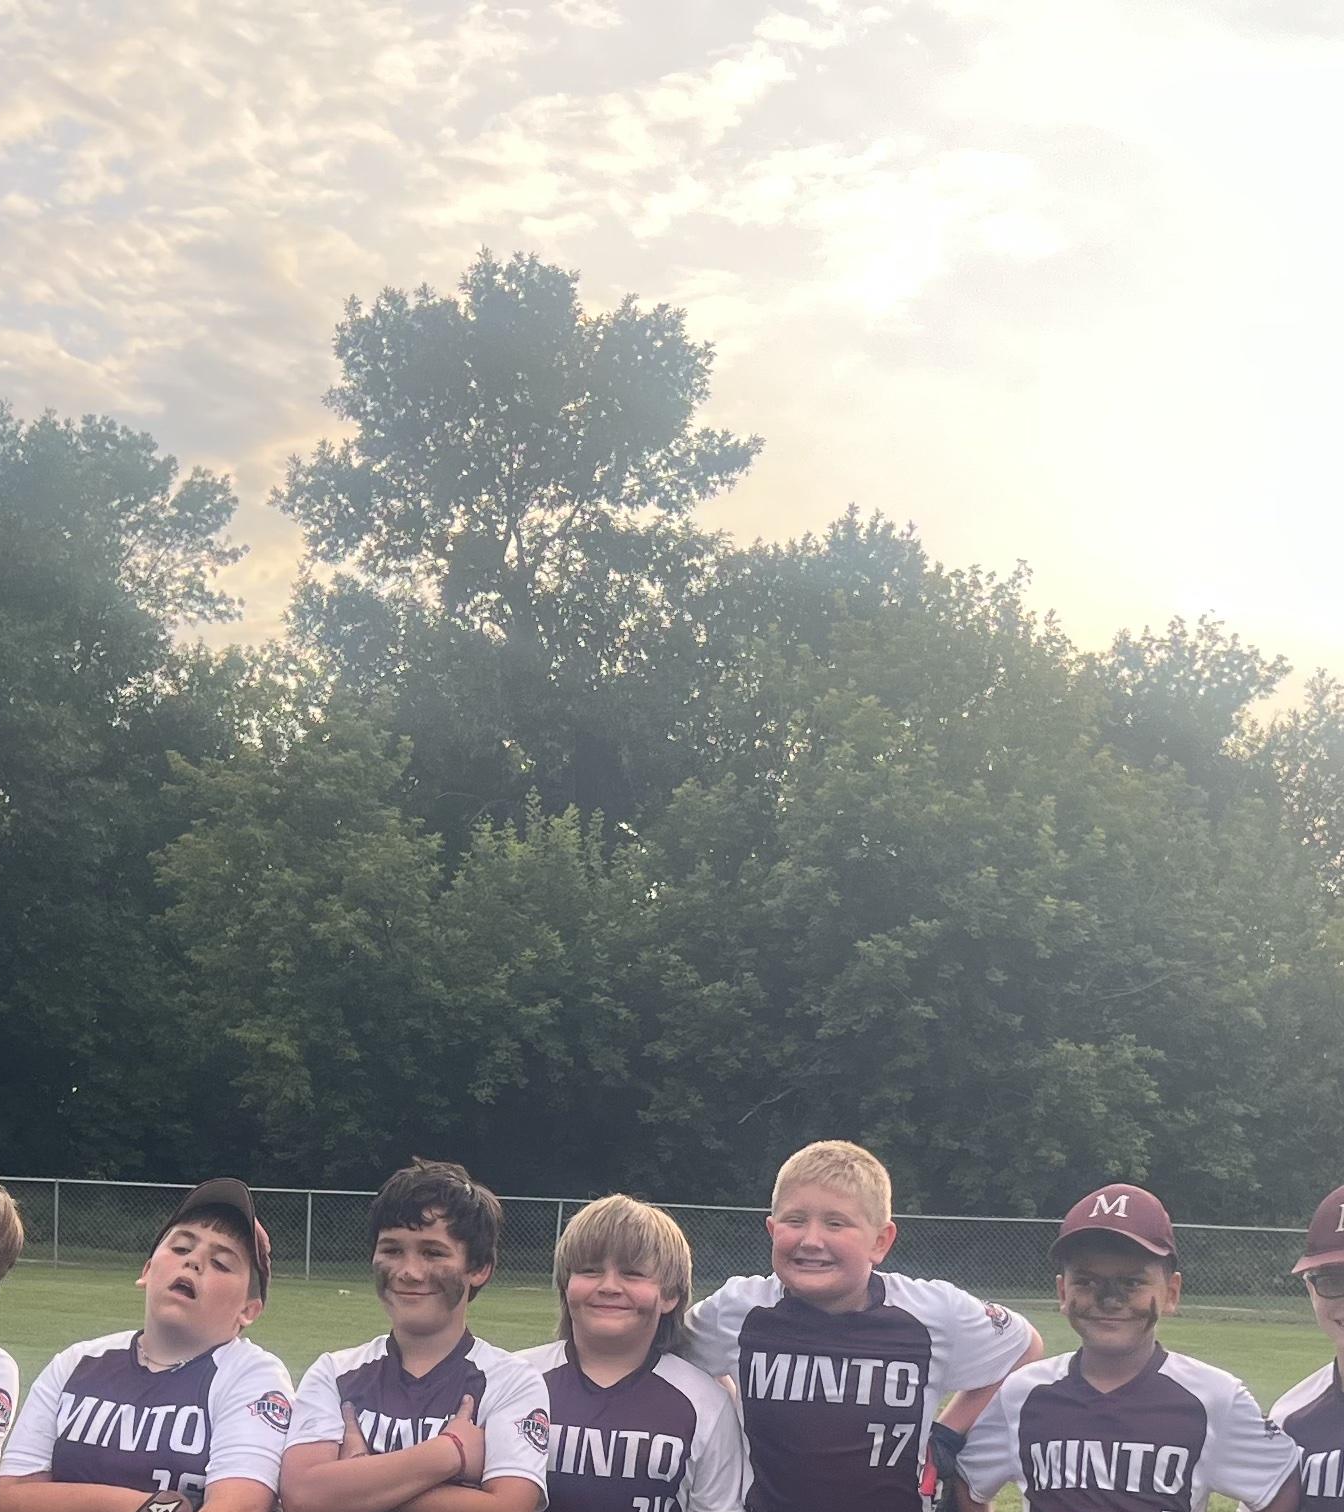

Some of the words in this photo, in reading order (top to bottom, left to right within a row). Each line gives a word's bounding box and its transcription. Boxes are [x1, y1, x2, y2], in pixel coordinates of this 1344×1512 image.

[1088, 1193, 1130, 1219] M
[747, 1351, 921, 1408] MINTO
[56, 1391, 206, 1455] MINTO
[866, 1423, 916, 1468] 17
[1030, 1439, 1190, 1495] MINTO
